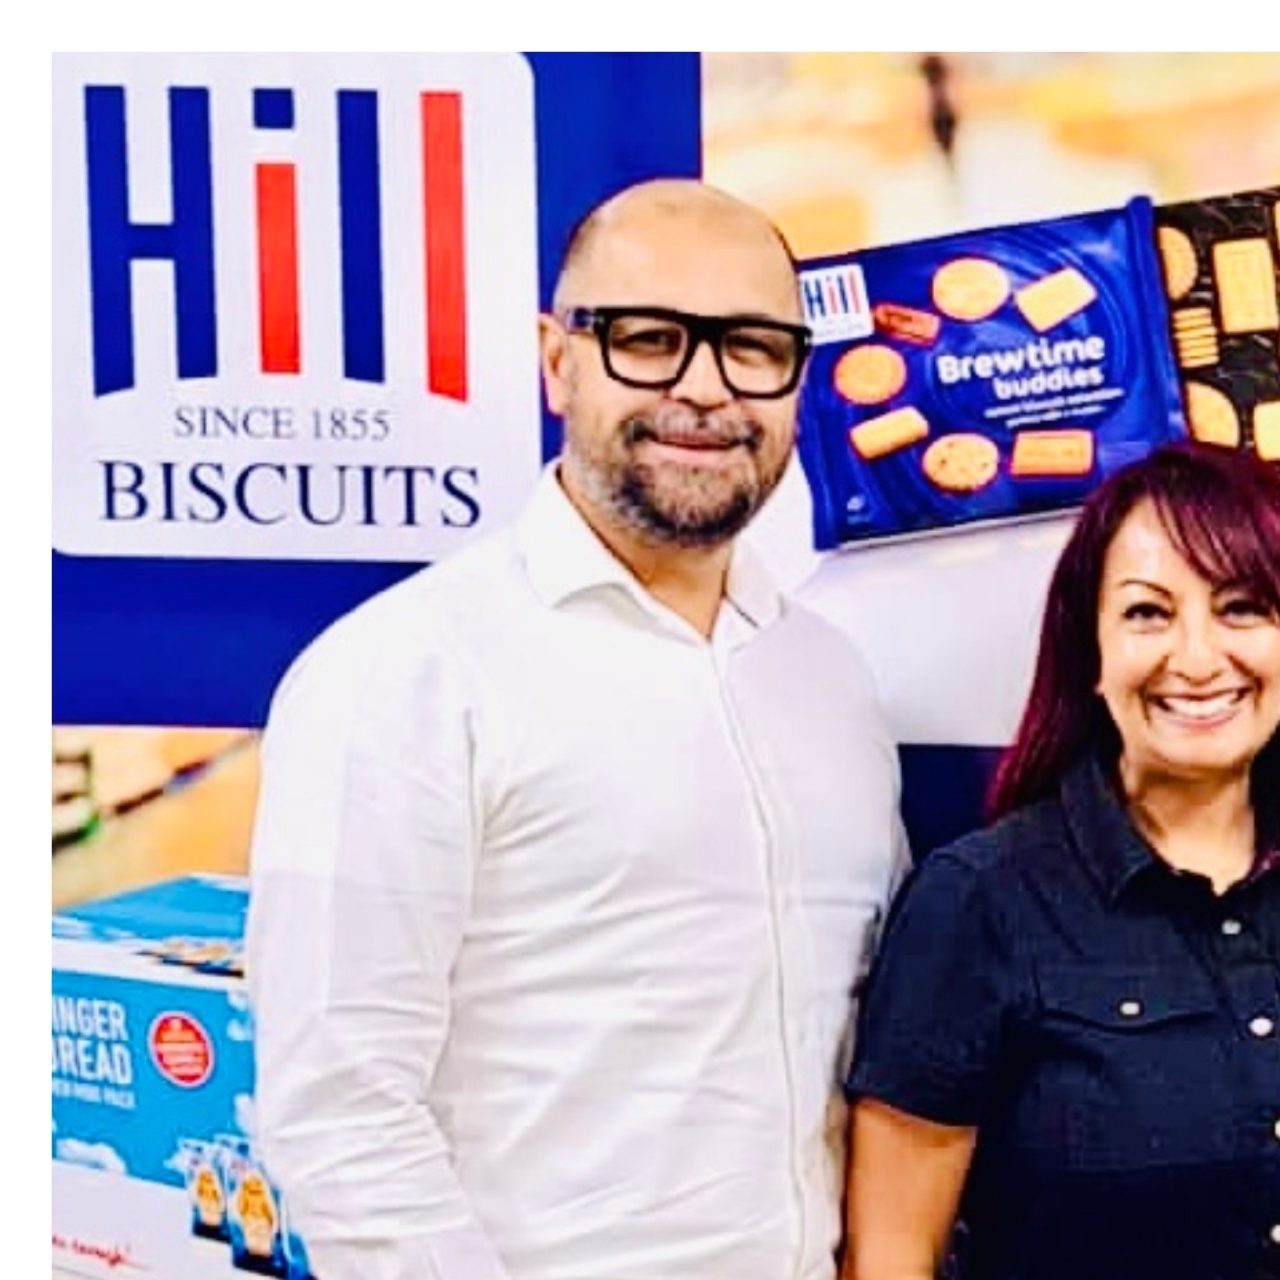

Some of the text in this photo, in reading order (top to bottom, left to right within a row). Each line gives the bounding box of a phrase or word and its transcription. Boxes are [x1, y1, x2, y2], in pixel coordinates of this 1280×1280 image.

[84, 84, 469, 404] Hill
[803, 271, 861, 320] Hill
[936, 336, 1106, 385] Brewtime
[993, 366, 1105, 400] buddies
[174, 405, 391, 442] SINCE 1855
[98, 459, 482, 528] BISCUITS
